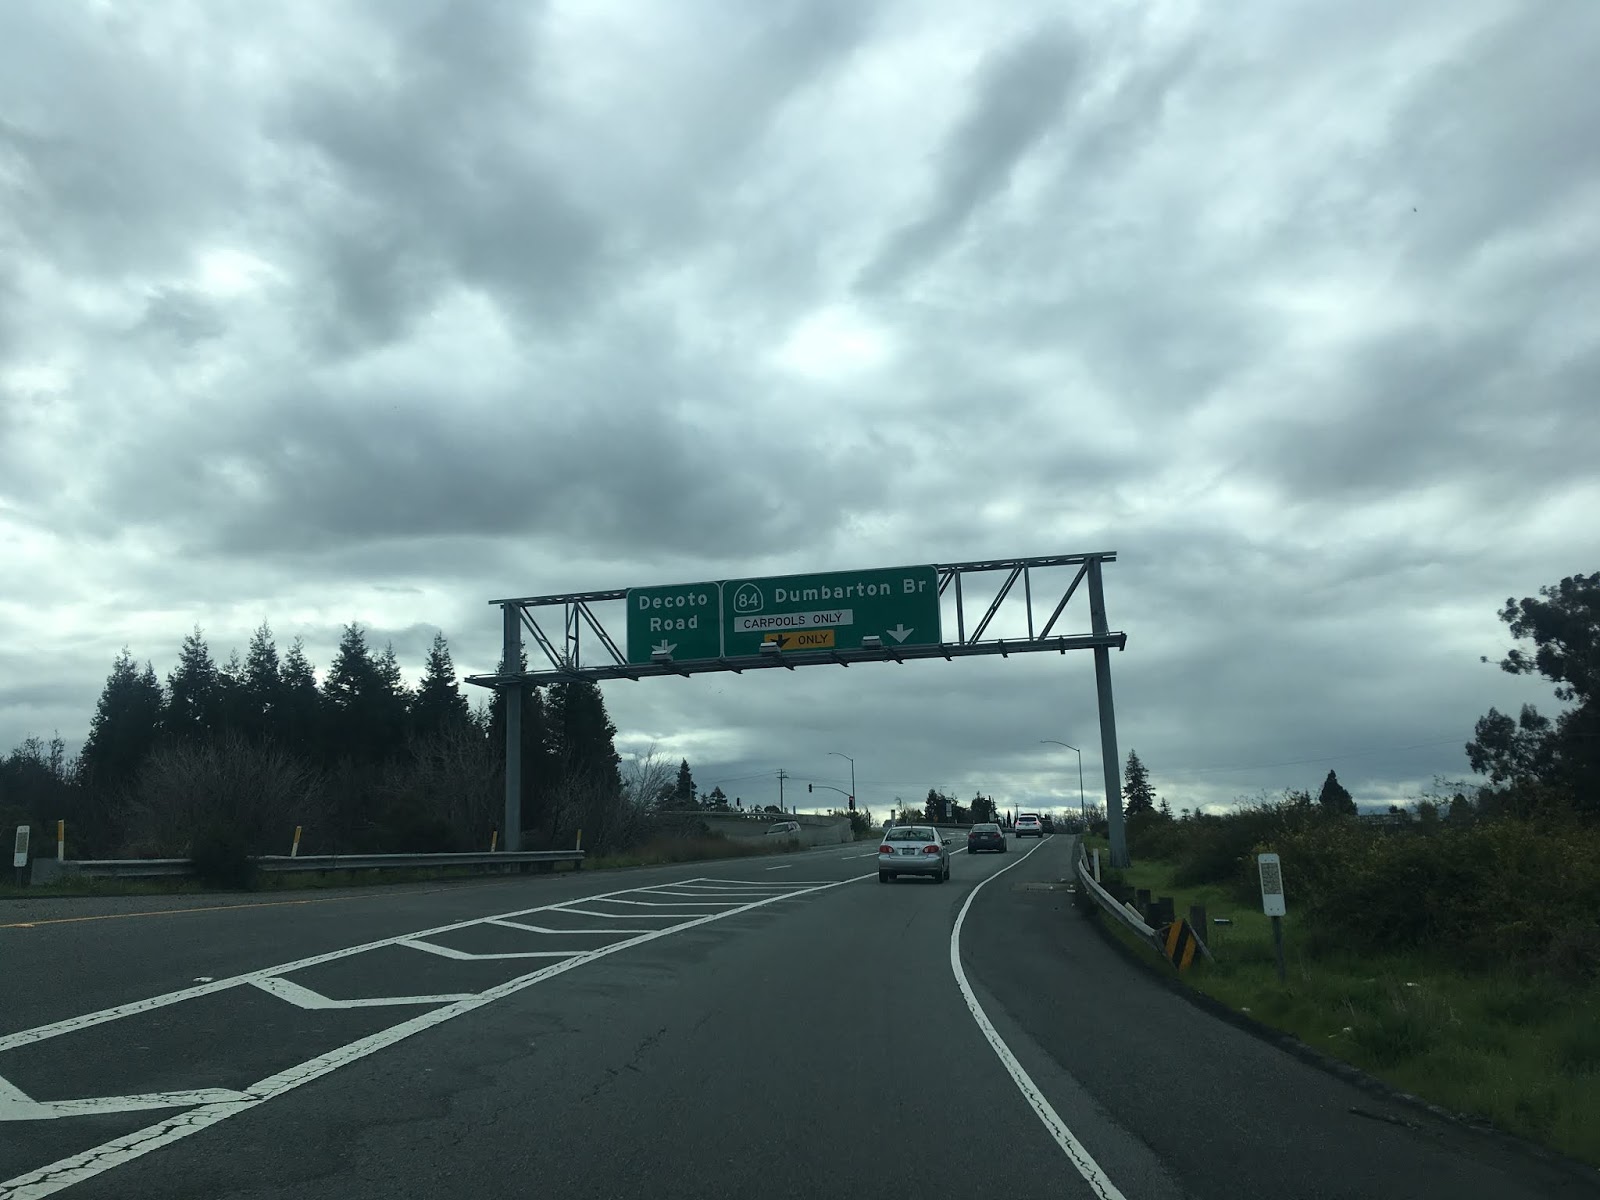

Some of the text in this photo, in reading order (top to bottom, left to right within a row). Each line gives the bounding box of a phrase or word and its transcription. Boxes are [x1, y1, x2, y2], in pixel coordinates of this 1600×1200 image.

[775, 579, 926, 603] Dumbarton Br
[639, 592, 708, 610] Decoto
[738, 593, 759, 607] 84
[650, 615, 698, 632] Road
[743, 612, 842, 629] CARPOOLS ONLY
[798, 634, 828, 645] ONLY
